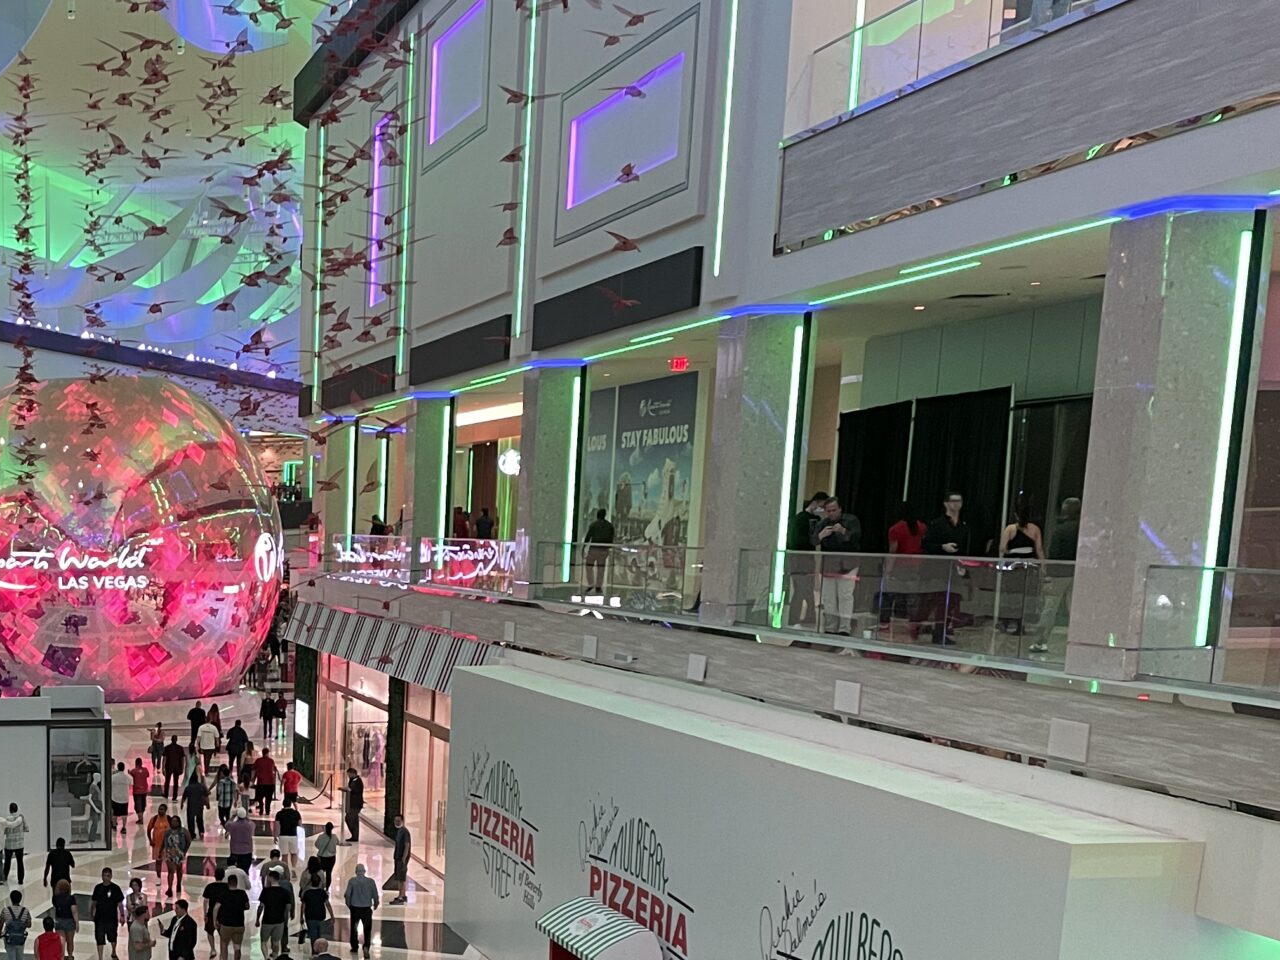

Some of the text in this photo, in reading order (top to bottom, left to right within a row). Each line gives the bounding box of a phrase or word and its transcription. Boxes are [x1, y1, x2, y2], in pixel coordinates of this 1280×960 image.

[673, 358, 688, 370] EXIT
[621, 424, 689, 449] STAY FABULOUS
[58, 546, 148, 570] World
[58, 575, 148, 591] LAS VEGAS
[483, 760, 523, 819] MULBERRY
[470, 801, 535, 868] PIZZERIA
[609, 817, 669, 895] MULBERRY
[482, 841, 519, 899] STREET
[589, 864, 689, 957] PIZZERIA
